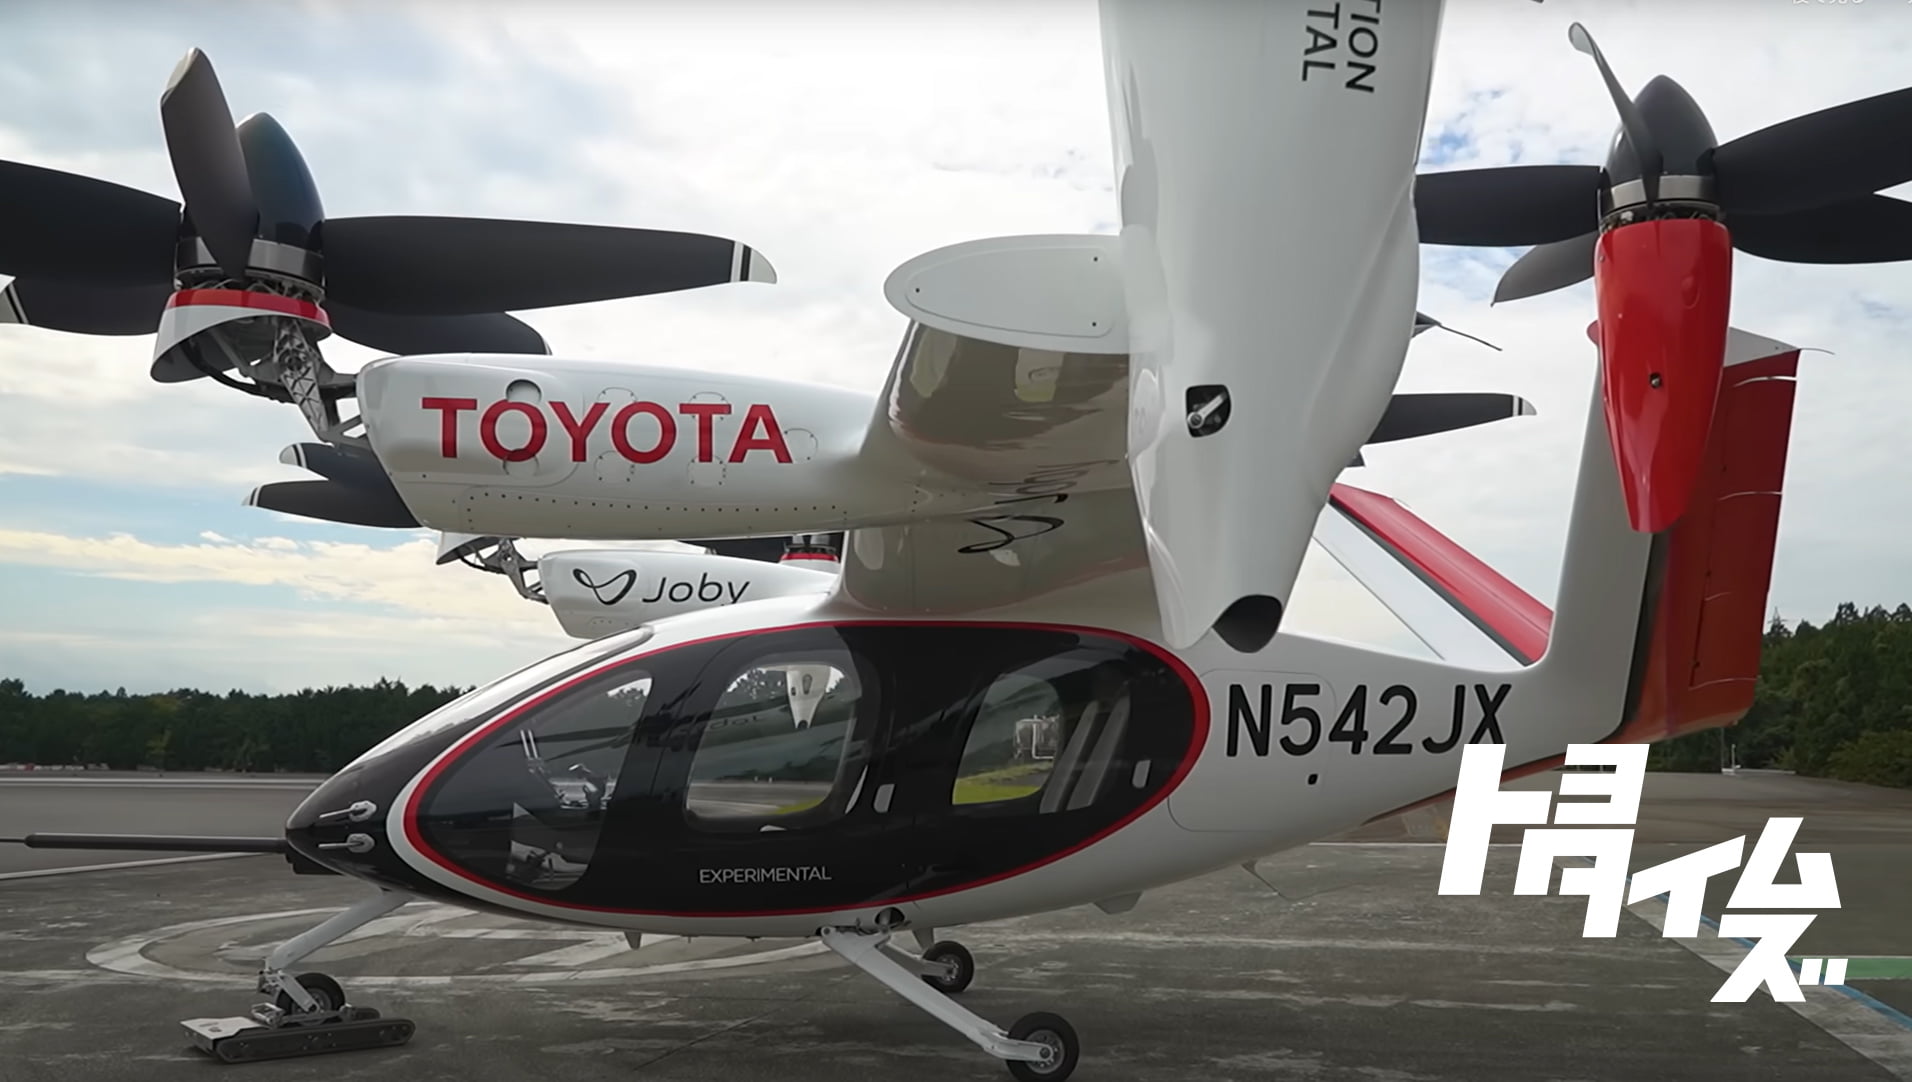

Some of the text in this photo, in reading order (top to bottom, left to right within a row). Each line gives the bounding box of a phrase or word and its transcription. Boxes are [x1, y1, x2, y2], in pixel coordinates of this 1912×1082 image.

[1302, 2, 1340, 81] TAL
[421, 397, 793, 464] TOYOTA
[641, 572, 750, 604] Joby
[1226, 683, 1512, 757] N542JX
[699, 866, 832, 883] EXPERIMENTAL
